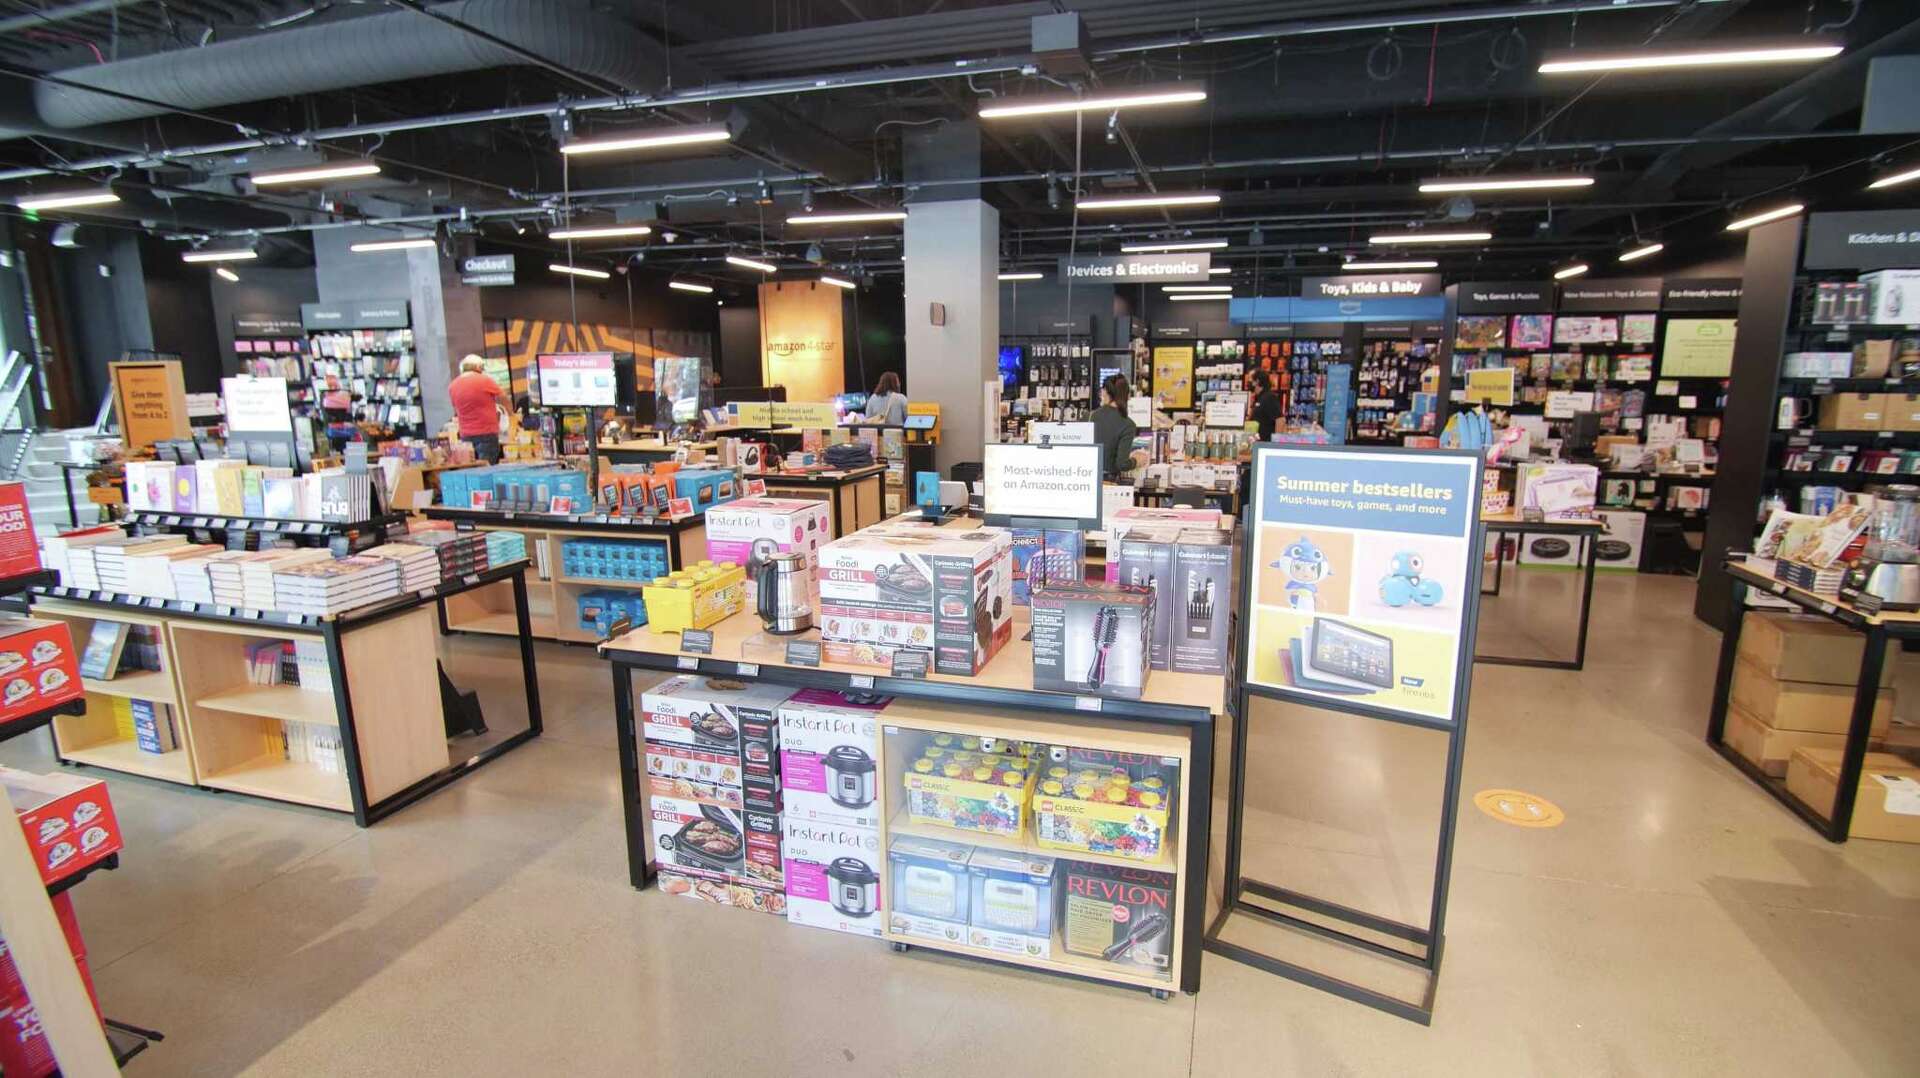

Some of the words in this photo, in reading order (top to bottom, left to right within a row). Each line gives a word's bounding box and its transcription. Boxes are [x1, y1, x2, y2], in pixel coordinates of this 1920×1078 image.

[465, 259, 507, 271] Checkout
[1067, 265, 1113, 277] Devices
[1115, 264, 1126, 276] &
[1129, 261, 1199, 275] Electronics
[1320, 283, 1350, 297] Toys,
[1352, 281, 1378, 294] Kids
[1379, 281, 1389, 293] &
[1392, 279, 1422, 295] Baby
[1489, 292, 1509, 300] Games
[767, 341, 806, 352] amazon
[1004, 465, 1092, 477] Most-wished-for
[1020, 480, 1091, 492] Amazon.com
[1277, 476, 1349, 493] Summer
[1353, 480, 1453, 500] bestsellers
[321, 500, 348, 515] snug
[1279, 494, 1329, 507] Must-have
[1331, 497, 1354, 510] toys,
[1357, 500, 1393, 512] games,
[1395, 502, 1416, 513] and
[1418, 504, 1447, 515] more
[709, 514, 742, 528] Instant
[744, 516, 761, 528] Pot
[829, 570, 865, 582] GRILL
[652, 714, 683, 727] GRILL
[783, 714, 831, 733] Instant
[834, 718, 857, 735] Pot
[785, 738, 803, 746] DUO
[1055, 803, 1085, 814] CLASSIC
[789, 824, 835, 844] Instant
[839, 830, 861, 848] Pot
[791, 848, 808, 857] DUO
[1067, 875, 1168, 909] REVLON
